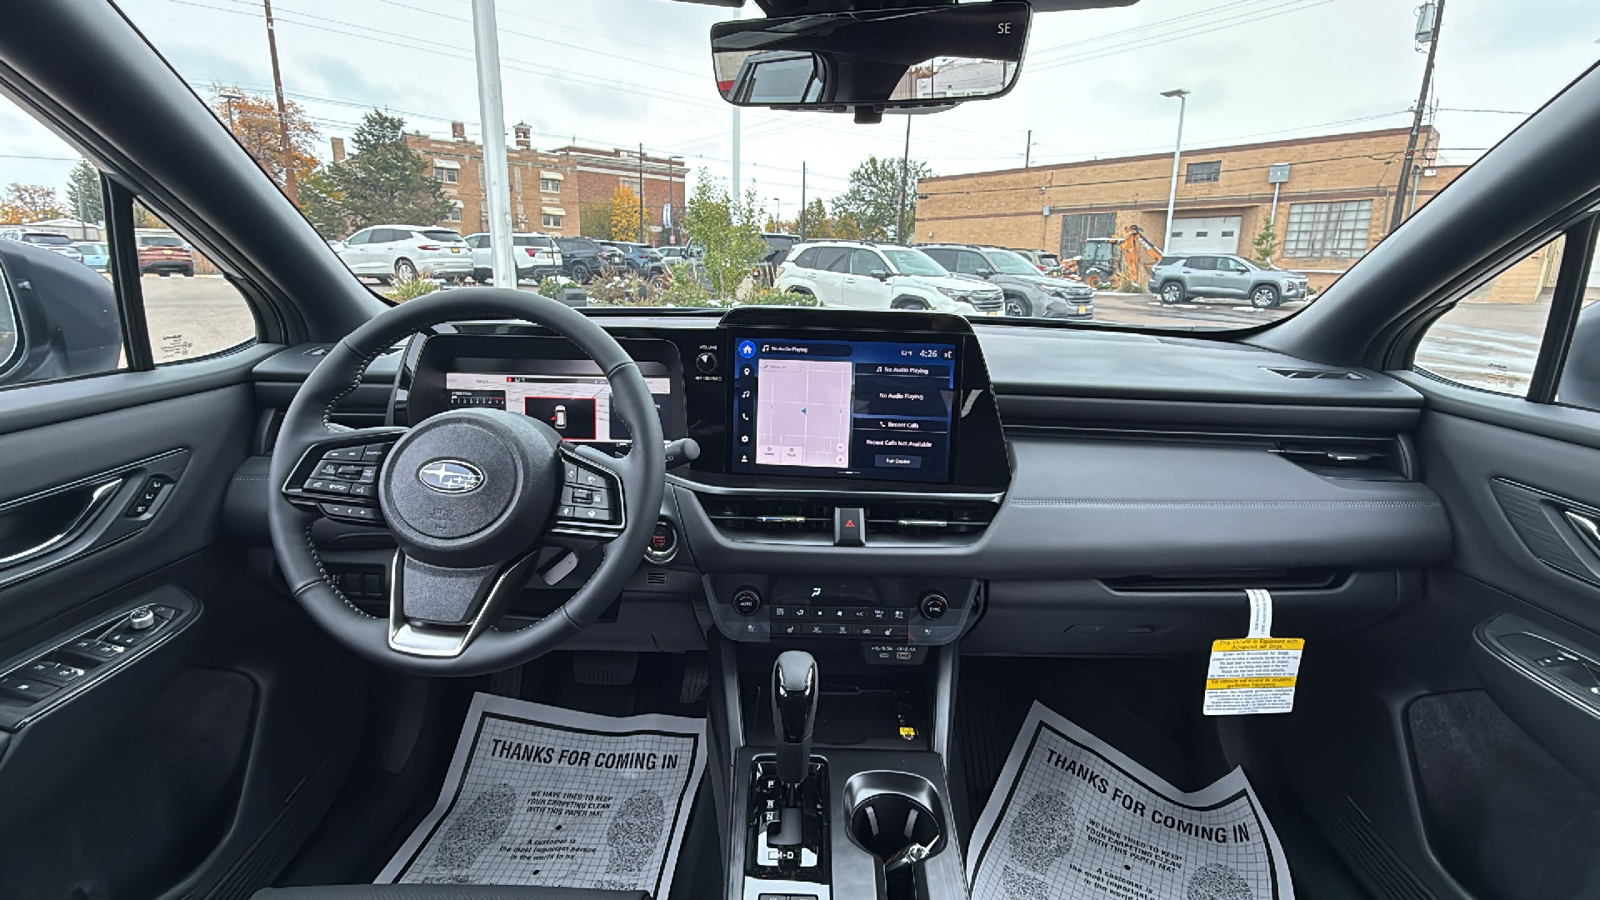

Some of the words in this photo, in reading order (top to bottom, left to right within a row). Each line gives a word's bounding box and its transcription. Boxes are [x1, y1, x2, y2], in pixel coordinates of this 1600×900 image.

[997, 22, 1011, 34] SE
[920, 350, 938, 358] 4:26
[492, 738, 555, 764] THANKS
[558, 750, 590, 766] FOR
[594, 752, 656, 770] COMING
[661, 754, 678, 769] IN
[547, 800, 586, 808] CARPETING
[1047, 748, 1109, 794] THANKS
[1112, 787, 1146, 818] FOR
[1151, 810, 1227, 844] COMING
[1232, 822, 1250, 843] IN
[570, 847, 597, 855] person
[1086, 825, 1106, 840] YOUR
[1108, 836, 1152, 858] CARPETING
[1154, 854, 1182, 868] CLEAN
[1089, 818, 1100, 828] WE
[1101, 826, 1120, 839] HAVE
[1123, 834, 1146, 848] TRIED
[1149, 844, 1159, 853] TO
[1161, 850, 1182, 860] KEEP
[1088, 835, 1108, 848] WITH
[1110, 844, 1127, 855] THIS
[1130, 852, 1155, 867] PAPER
[1158, 863, 1176, 873] MAT
[1070, 863, 1082, 873] the
[1084, 871, 1104, 882] most
[1106, 880, 1147, 899] important
[1094, 882, 1107, 891] the
[1105, 871, 1143, 890] customer
